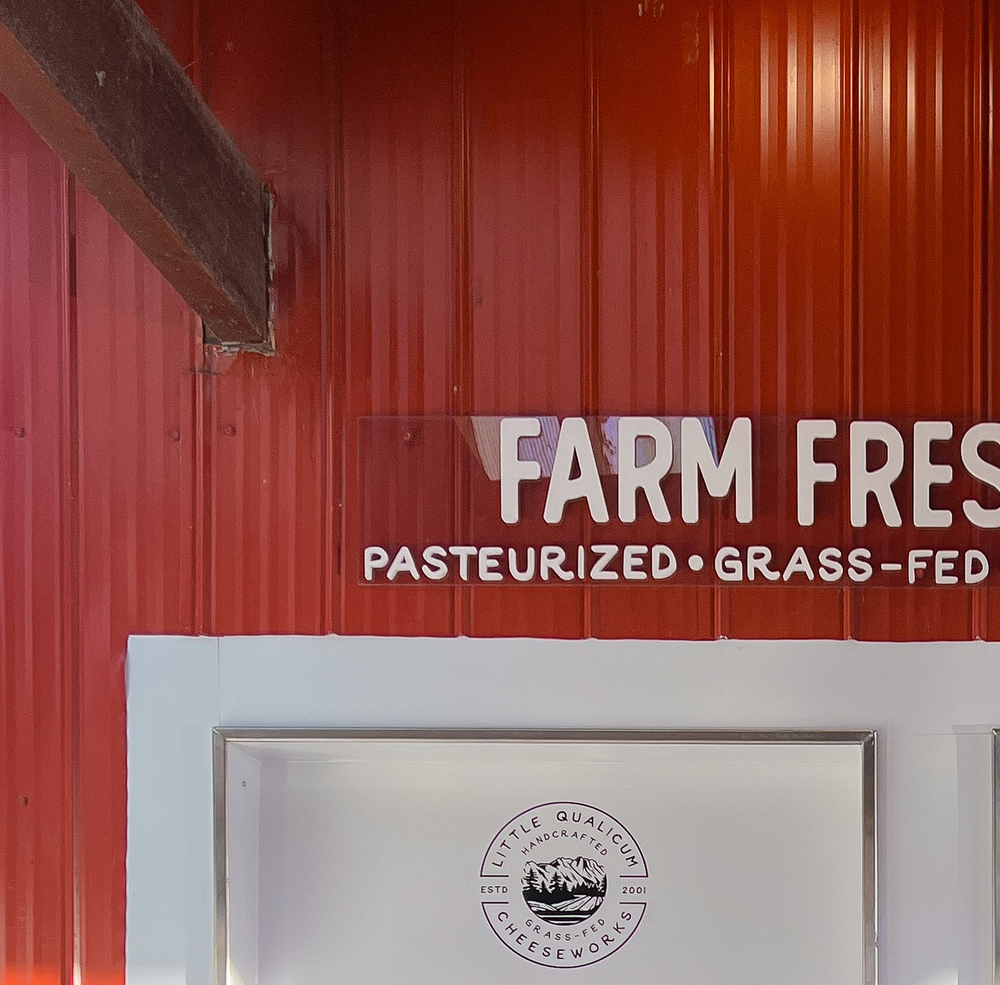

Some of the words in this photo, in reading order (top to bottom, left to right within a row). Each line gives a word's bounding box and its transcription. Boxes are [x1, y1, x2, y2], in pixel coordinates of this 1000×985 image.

[500, 416, 752, 524] FARM
[364, 545, 677, 580] PASTEURIZED
[714, 546, 990, 584] GRASS-FED
[492, 816, 542, 868] LITTLE
[556, 810, 638, 868] QUALICUM
[521, 830, 608, 856] HANDCRAFTED
[480, 886, 508, 894] ESTD
[622, 886, 646, 894] 2001
[498, 911, 632, 960] CHEESEWORKS
[526, 918, 606, 942] GRASS-FED
